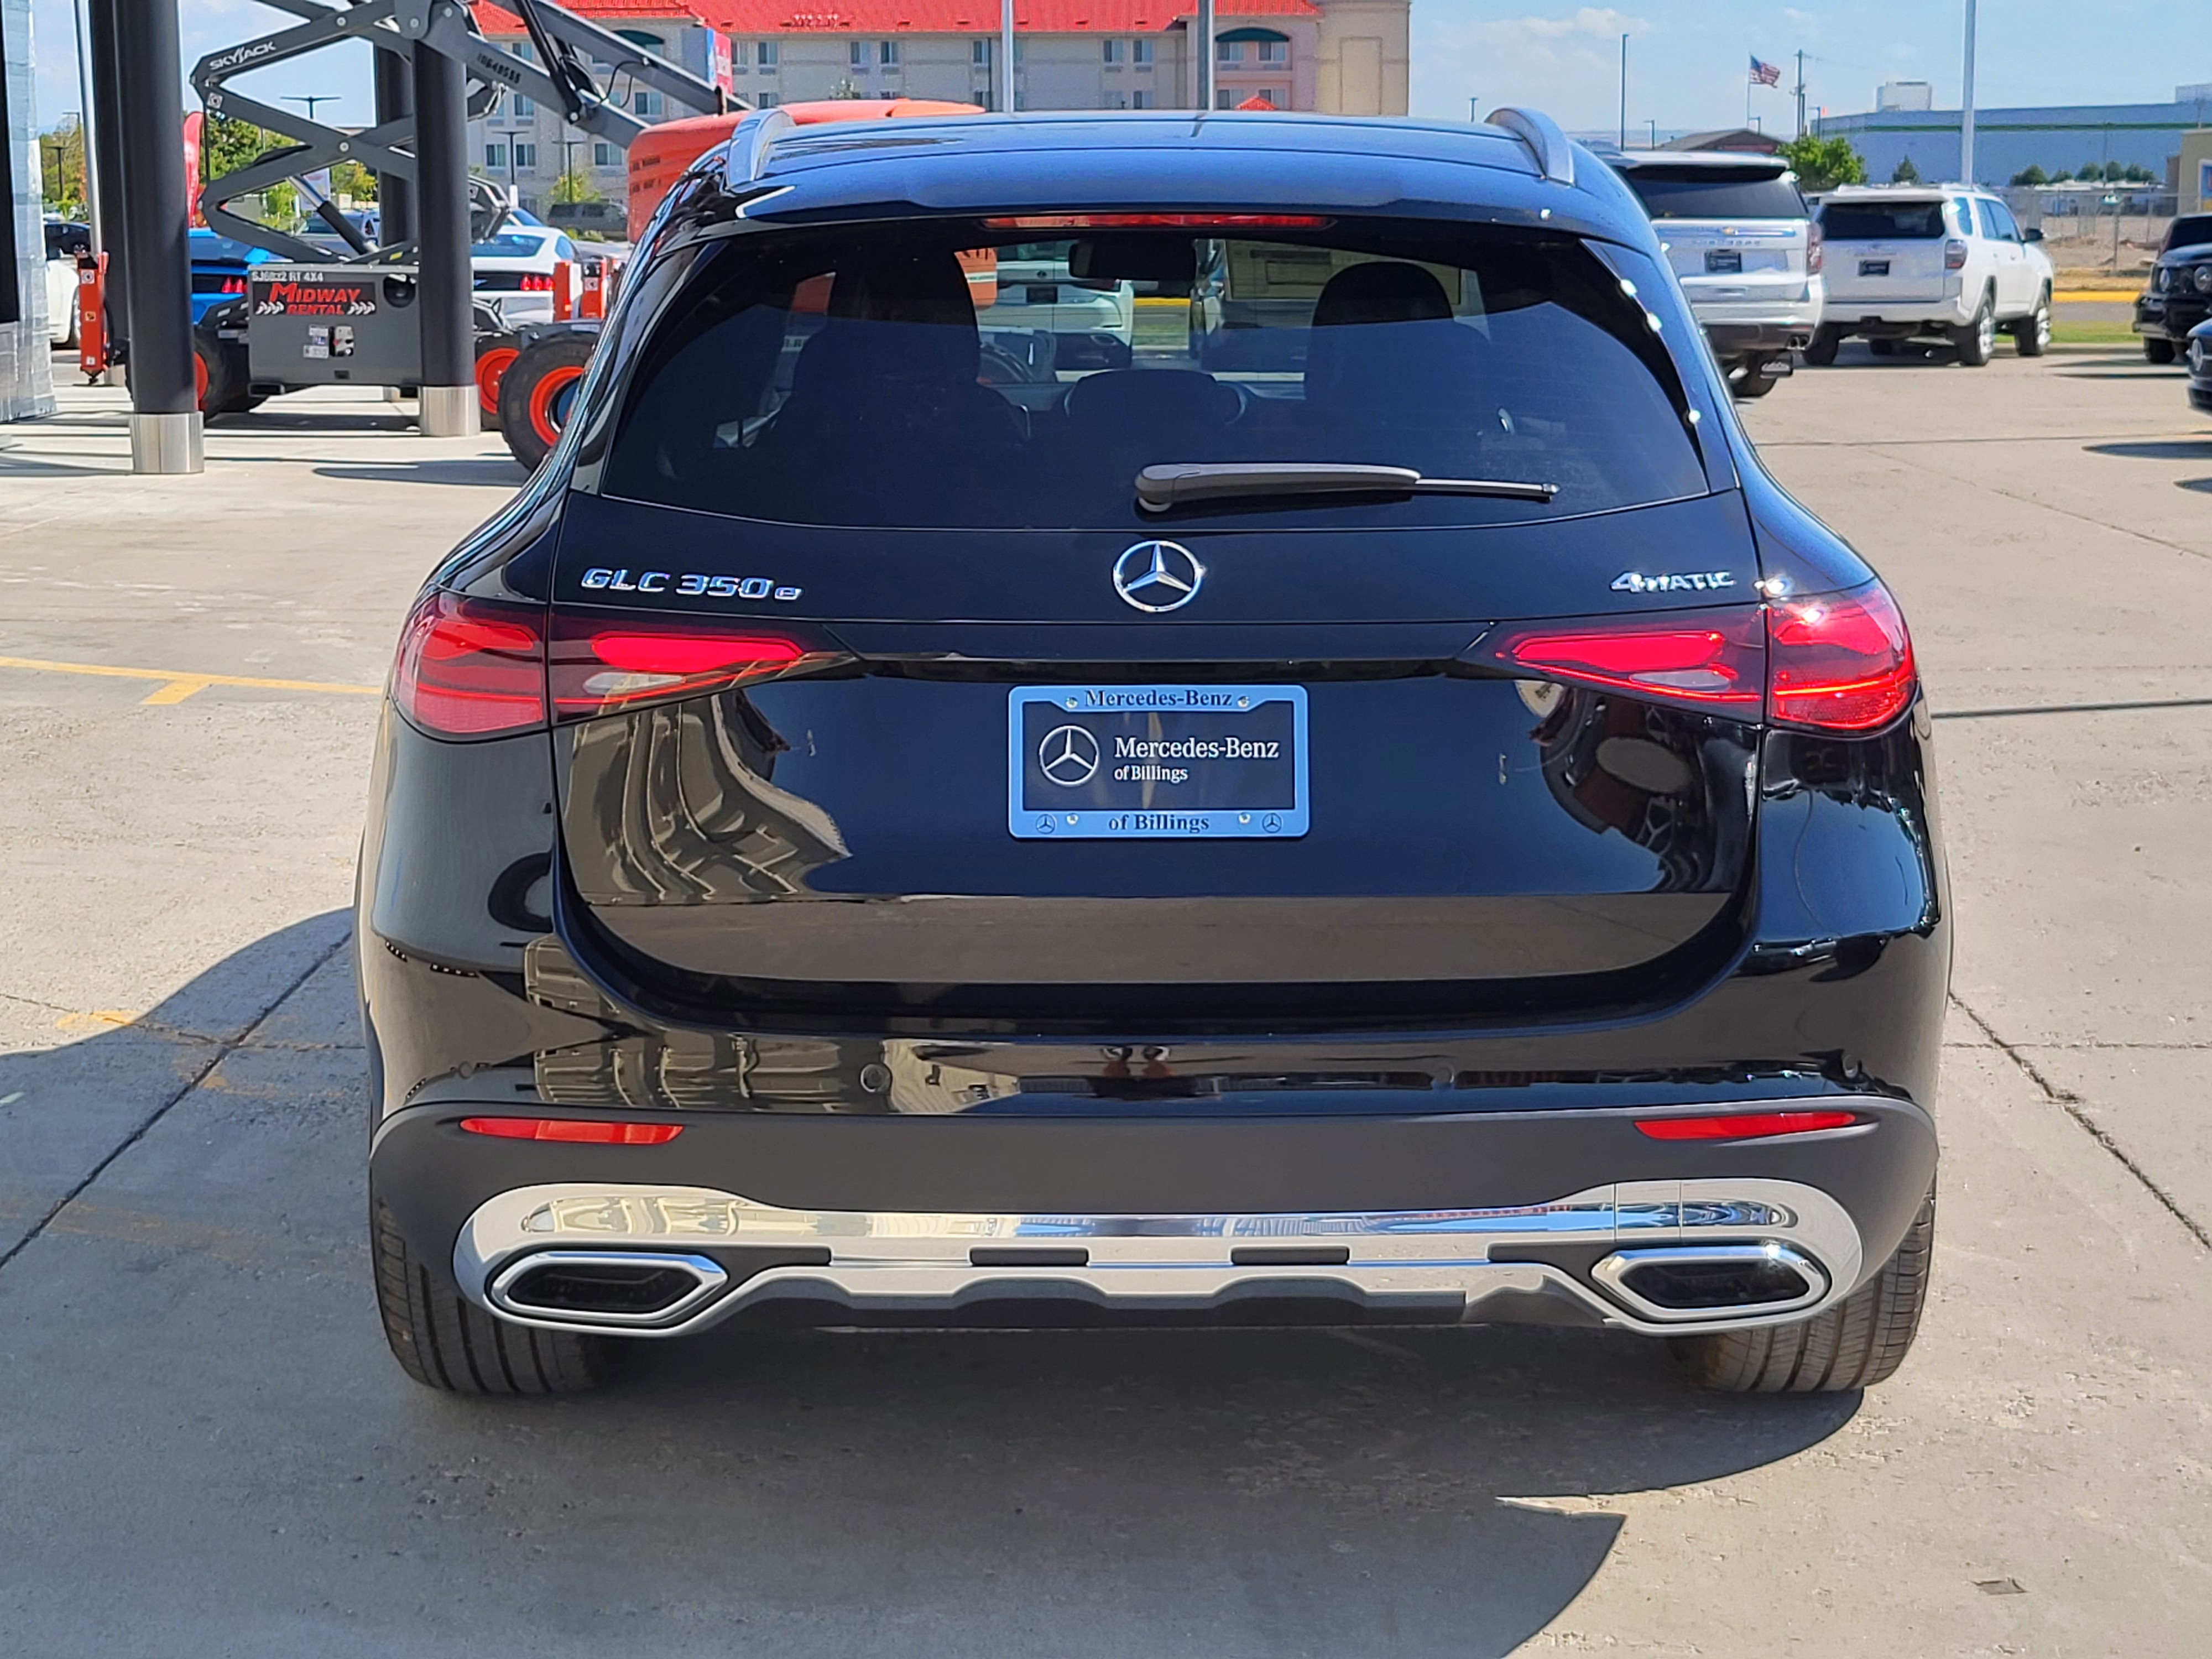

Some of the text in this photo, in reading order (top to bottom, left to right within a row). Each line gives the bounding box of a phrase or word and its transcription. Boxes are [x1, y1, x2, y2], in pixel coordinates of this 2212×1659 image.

[209, 41, 276, 70] SKYJACK
[304, 272, 324, 282] 4X4
[269, 282, 361, 302] MIDWAY
[286, 304, 345, 315] RENTAL
[581, 567, 671, 592] GLC
[1610, 571, 1737, 593] 4MATIC
[1084, 689, 1233, 707] Mercedes-Benz
[1114, 737, 1280, 758] Mercedes-Benz
[1114, 765, 1188, 784] of Billings
[1108, 813, 1210, 833] of Billings
